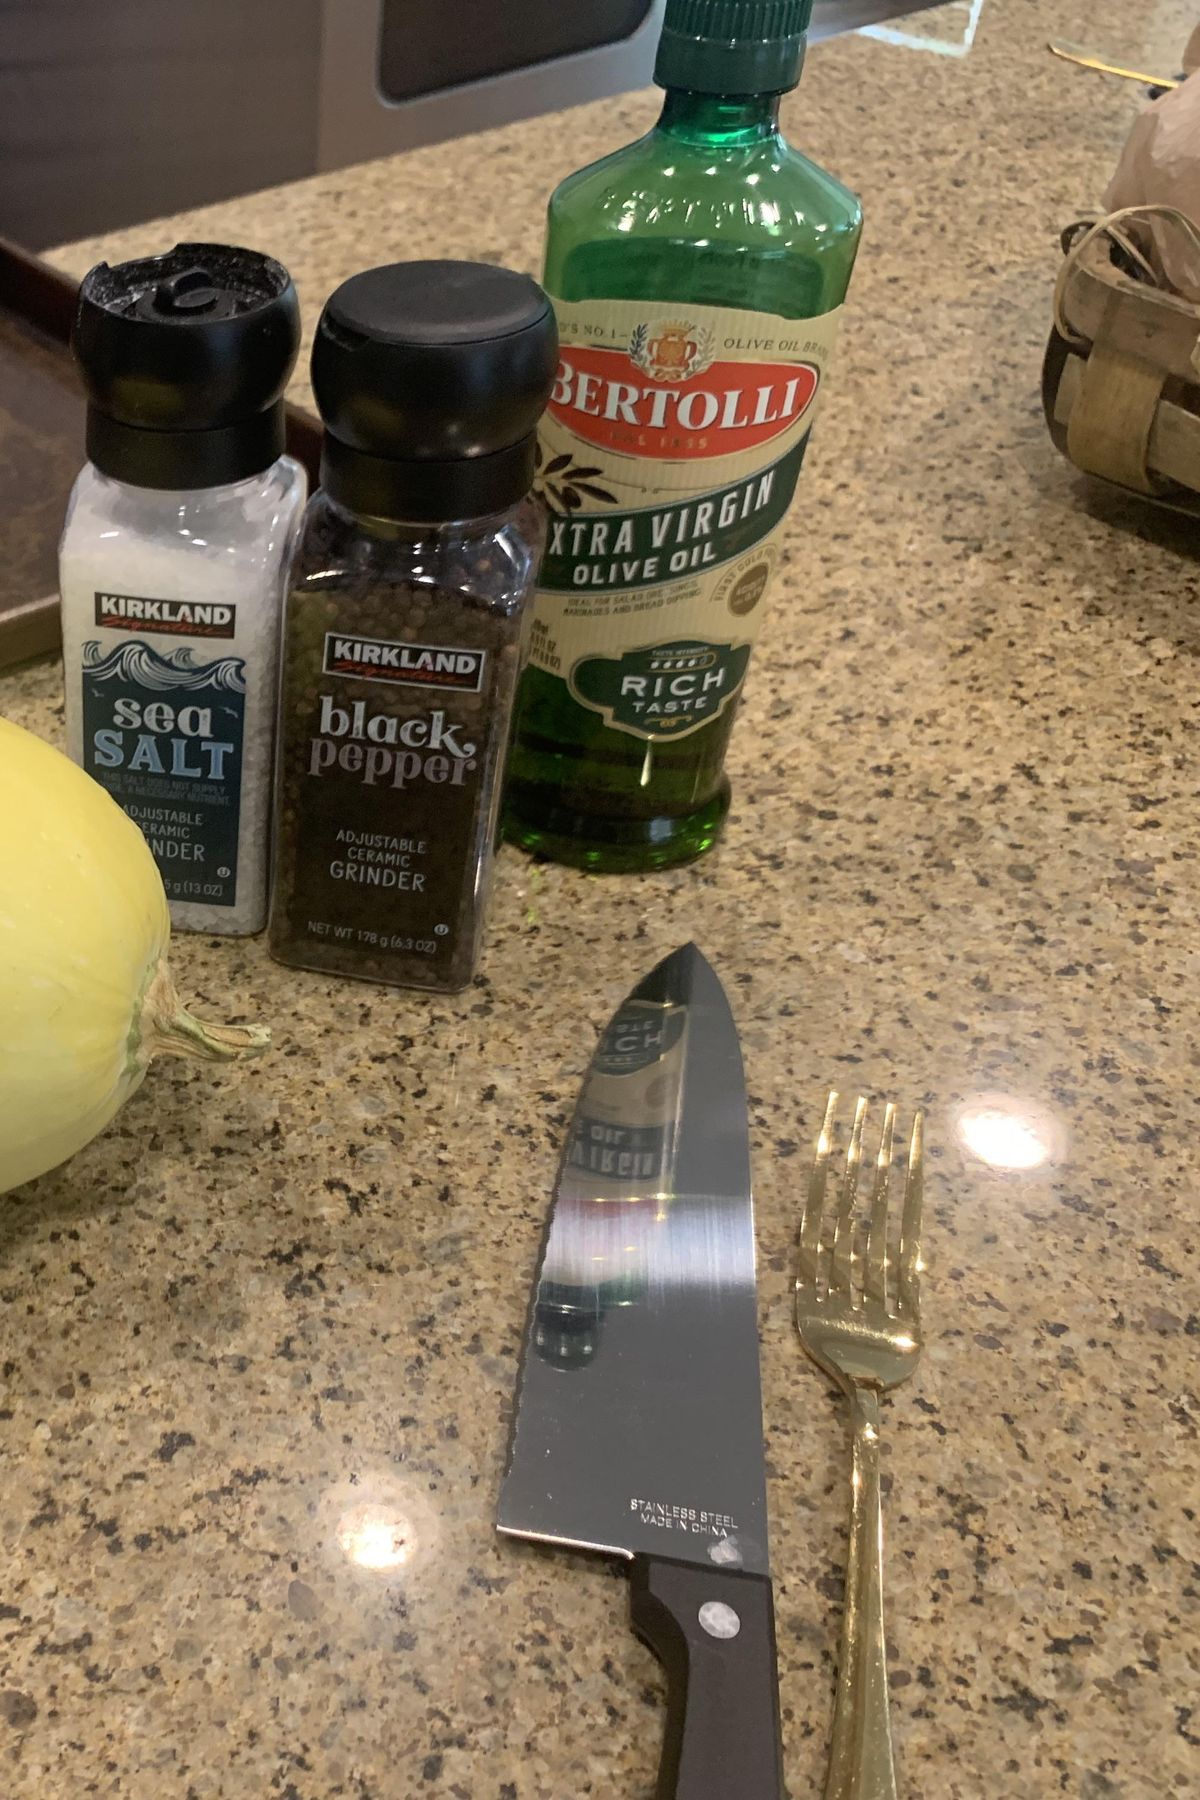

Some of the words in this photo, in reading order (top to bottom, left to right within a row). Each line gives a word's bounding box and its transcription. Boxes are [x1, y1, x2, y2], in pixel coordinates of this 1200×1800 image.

[584, 325, 604, 337] NO
[723, 338, 775, 351] OLIVE
[778, 340, 799, 352] OIL
[802, 341, 829, 361] BRA
[549, 358, 800, 431] BERTOLLI
[549, 517, 634, 556] XTRA
[651, 469, 775, 549] VIRGIN
[573, 557, 658, 585] OLIVE
[669, 542, 717, 573] OIL
[101, 595, 232, 626] KIRKLAND
[612, 604, 632, 614] AND
[334, 640, 477, 675] KIRKLAND
[620, 667, 726, 698] RICH
[112, 698, 213, 738] sea
[632, 697, 708, 714] TASTE
[319, 696, 477, 759] black
[93, 729, 234, 781] SALT
[306, 737, 477, 790] pepper
[123, 804, 204, 826] ADJUSTABLE
[151, 838, 206, 862] NDER
[336, 829, 427, 854] ADJUSTABLE
[347, 846, 411, 868] CERAMIC
[183, 881, 201, 895] (13
[203, 883, 224, 897] OZ)
[329, 860, 427, 893] GRINDER
[307, 920, 332, 936] NET
[333, 926, 354, 939] WT
[357, 930, 377, 944] 178
[379, 936, 388, 948] g
[415, 939, 437, 954] OZ)
[630, 1498, 696, 1520] STAINLESS
[700, 1511, 738, 1528] STEEL
[640, 1513, 673, 1528] MADE
[676, 1519, 688, 1531] IN
[691, 1522, 728, 1538] CHINA
